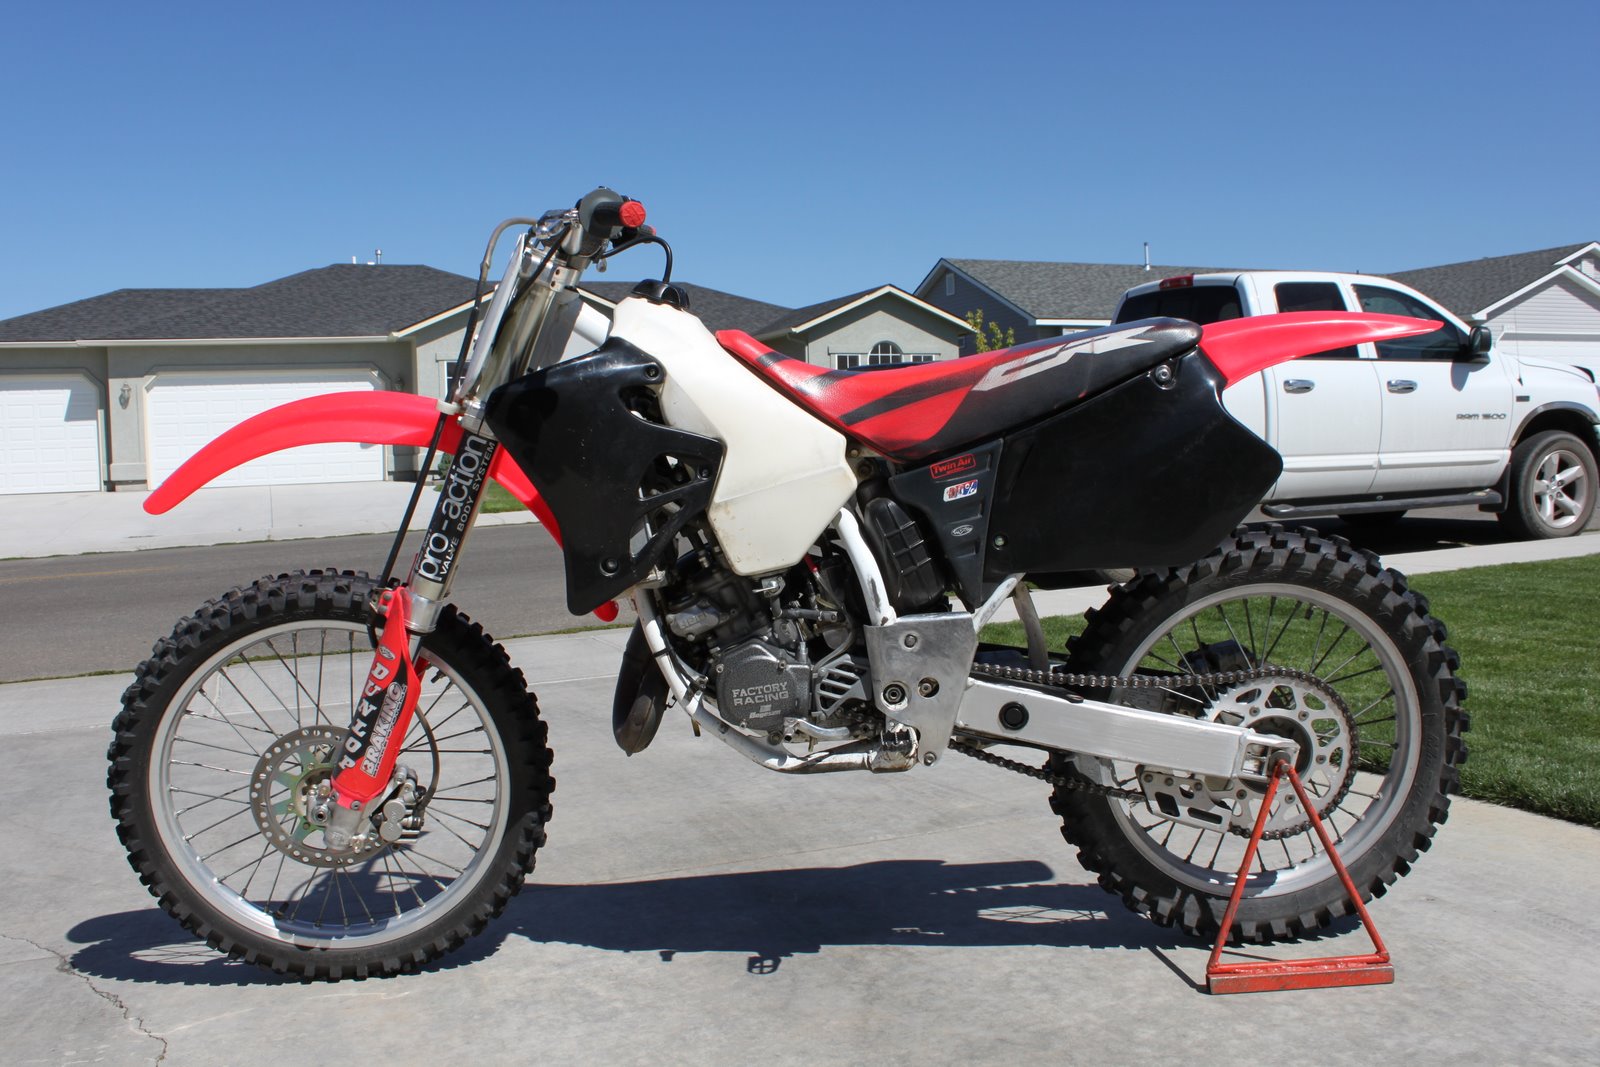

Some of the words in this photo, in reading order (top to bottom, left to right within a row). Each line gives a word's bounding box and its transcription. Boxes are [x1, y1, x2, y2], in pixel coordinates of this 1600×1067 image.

[932, 462, 957, 474] Twin
[957, 457, 972, 468] Air
[440, 537, 459, 575] VALVE
[457, 496, 474, 532] BODY
[473, 442, 496, 492] SYSTEM
[338, 662, 390, 770] DUNLOP
[732, 682, 788, 698] FACTORY
[733, 690, 789, 706] RACING
[360, 681, 402, 775] BRAKING
